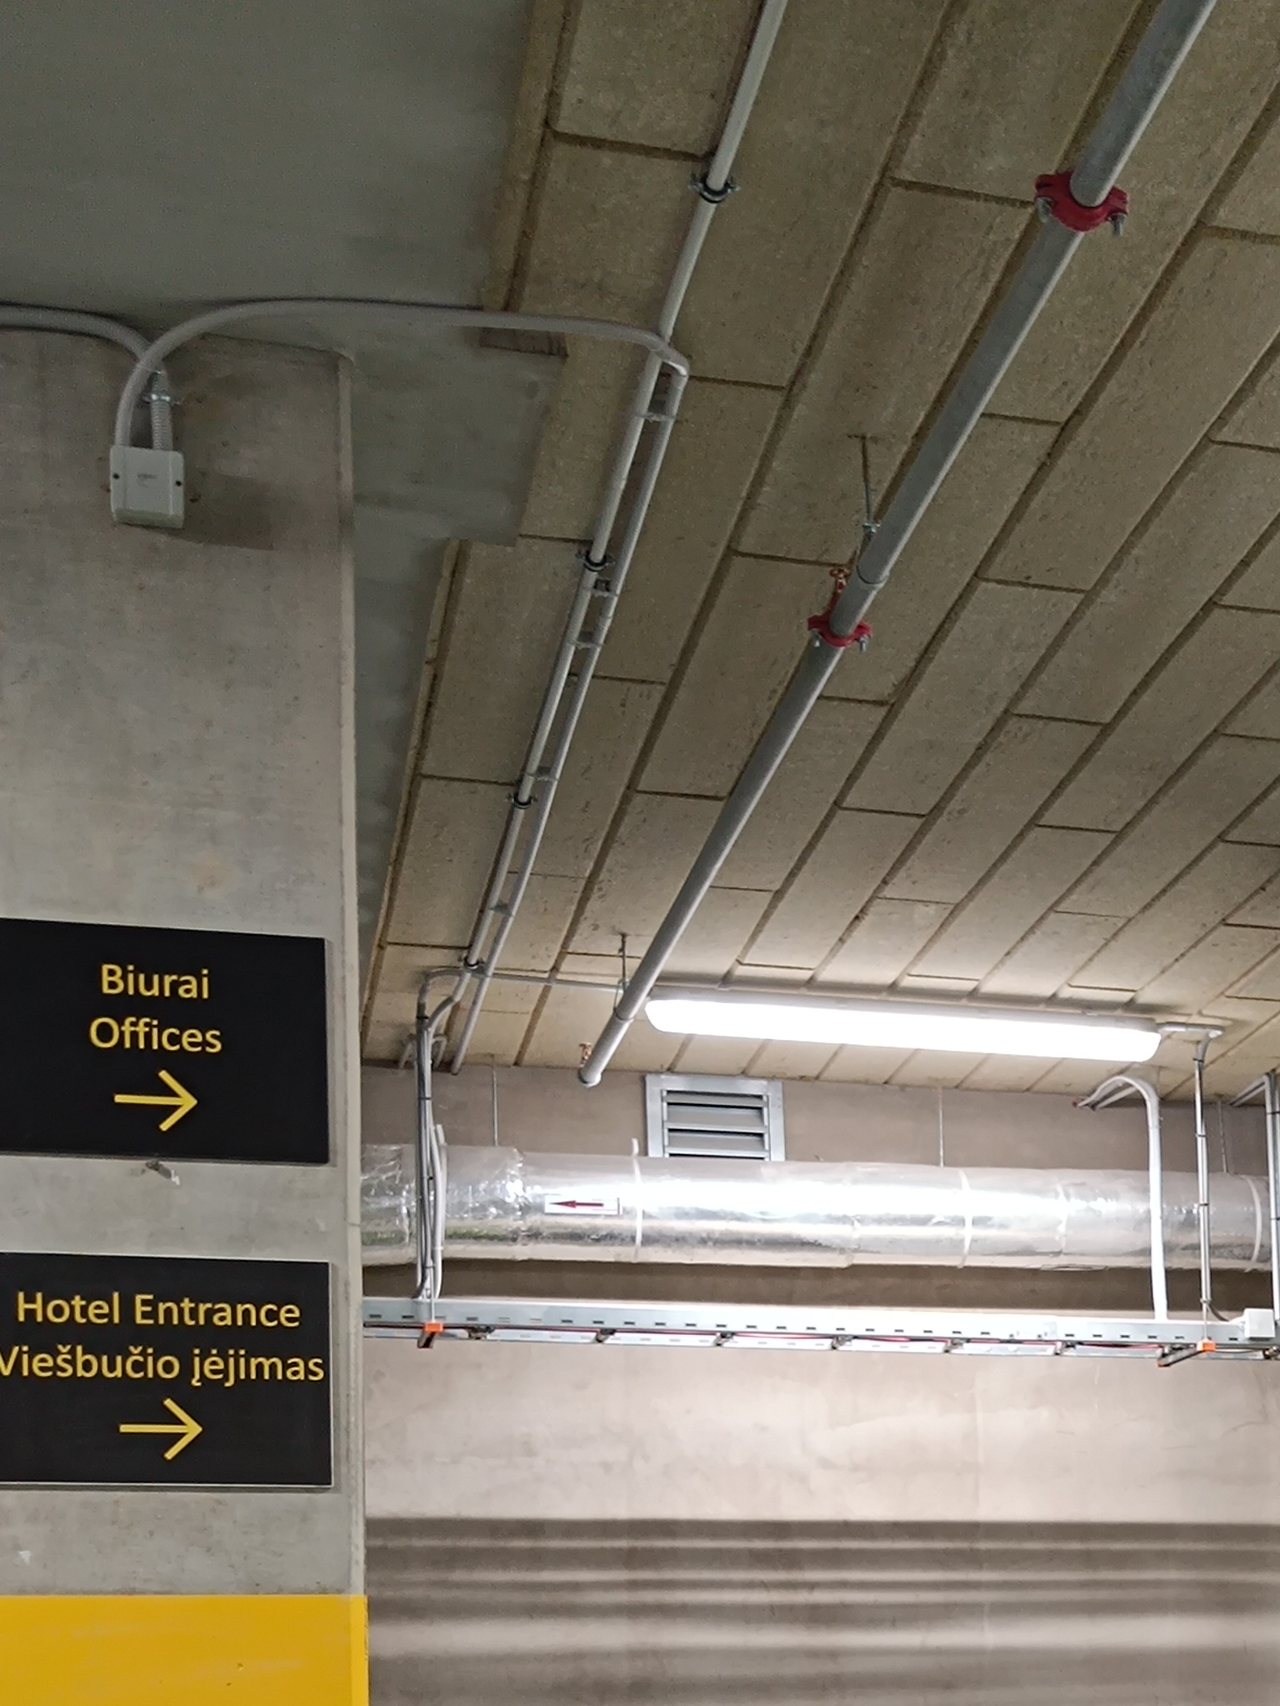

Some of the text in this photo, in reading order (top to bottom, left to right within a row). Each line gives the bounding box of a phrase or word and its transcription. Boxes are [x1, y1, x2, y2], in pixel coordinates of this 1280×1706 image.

[101, 963, 209, 999] Biurai
[89, 1016, 222, 1053] Offices
[17, 1291, 301, 1327] Hotel Entrance
[0, 1344, 325, 1387] Viešbučio įėjimas
